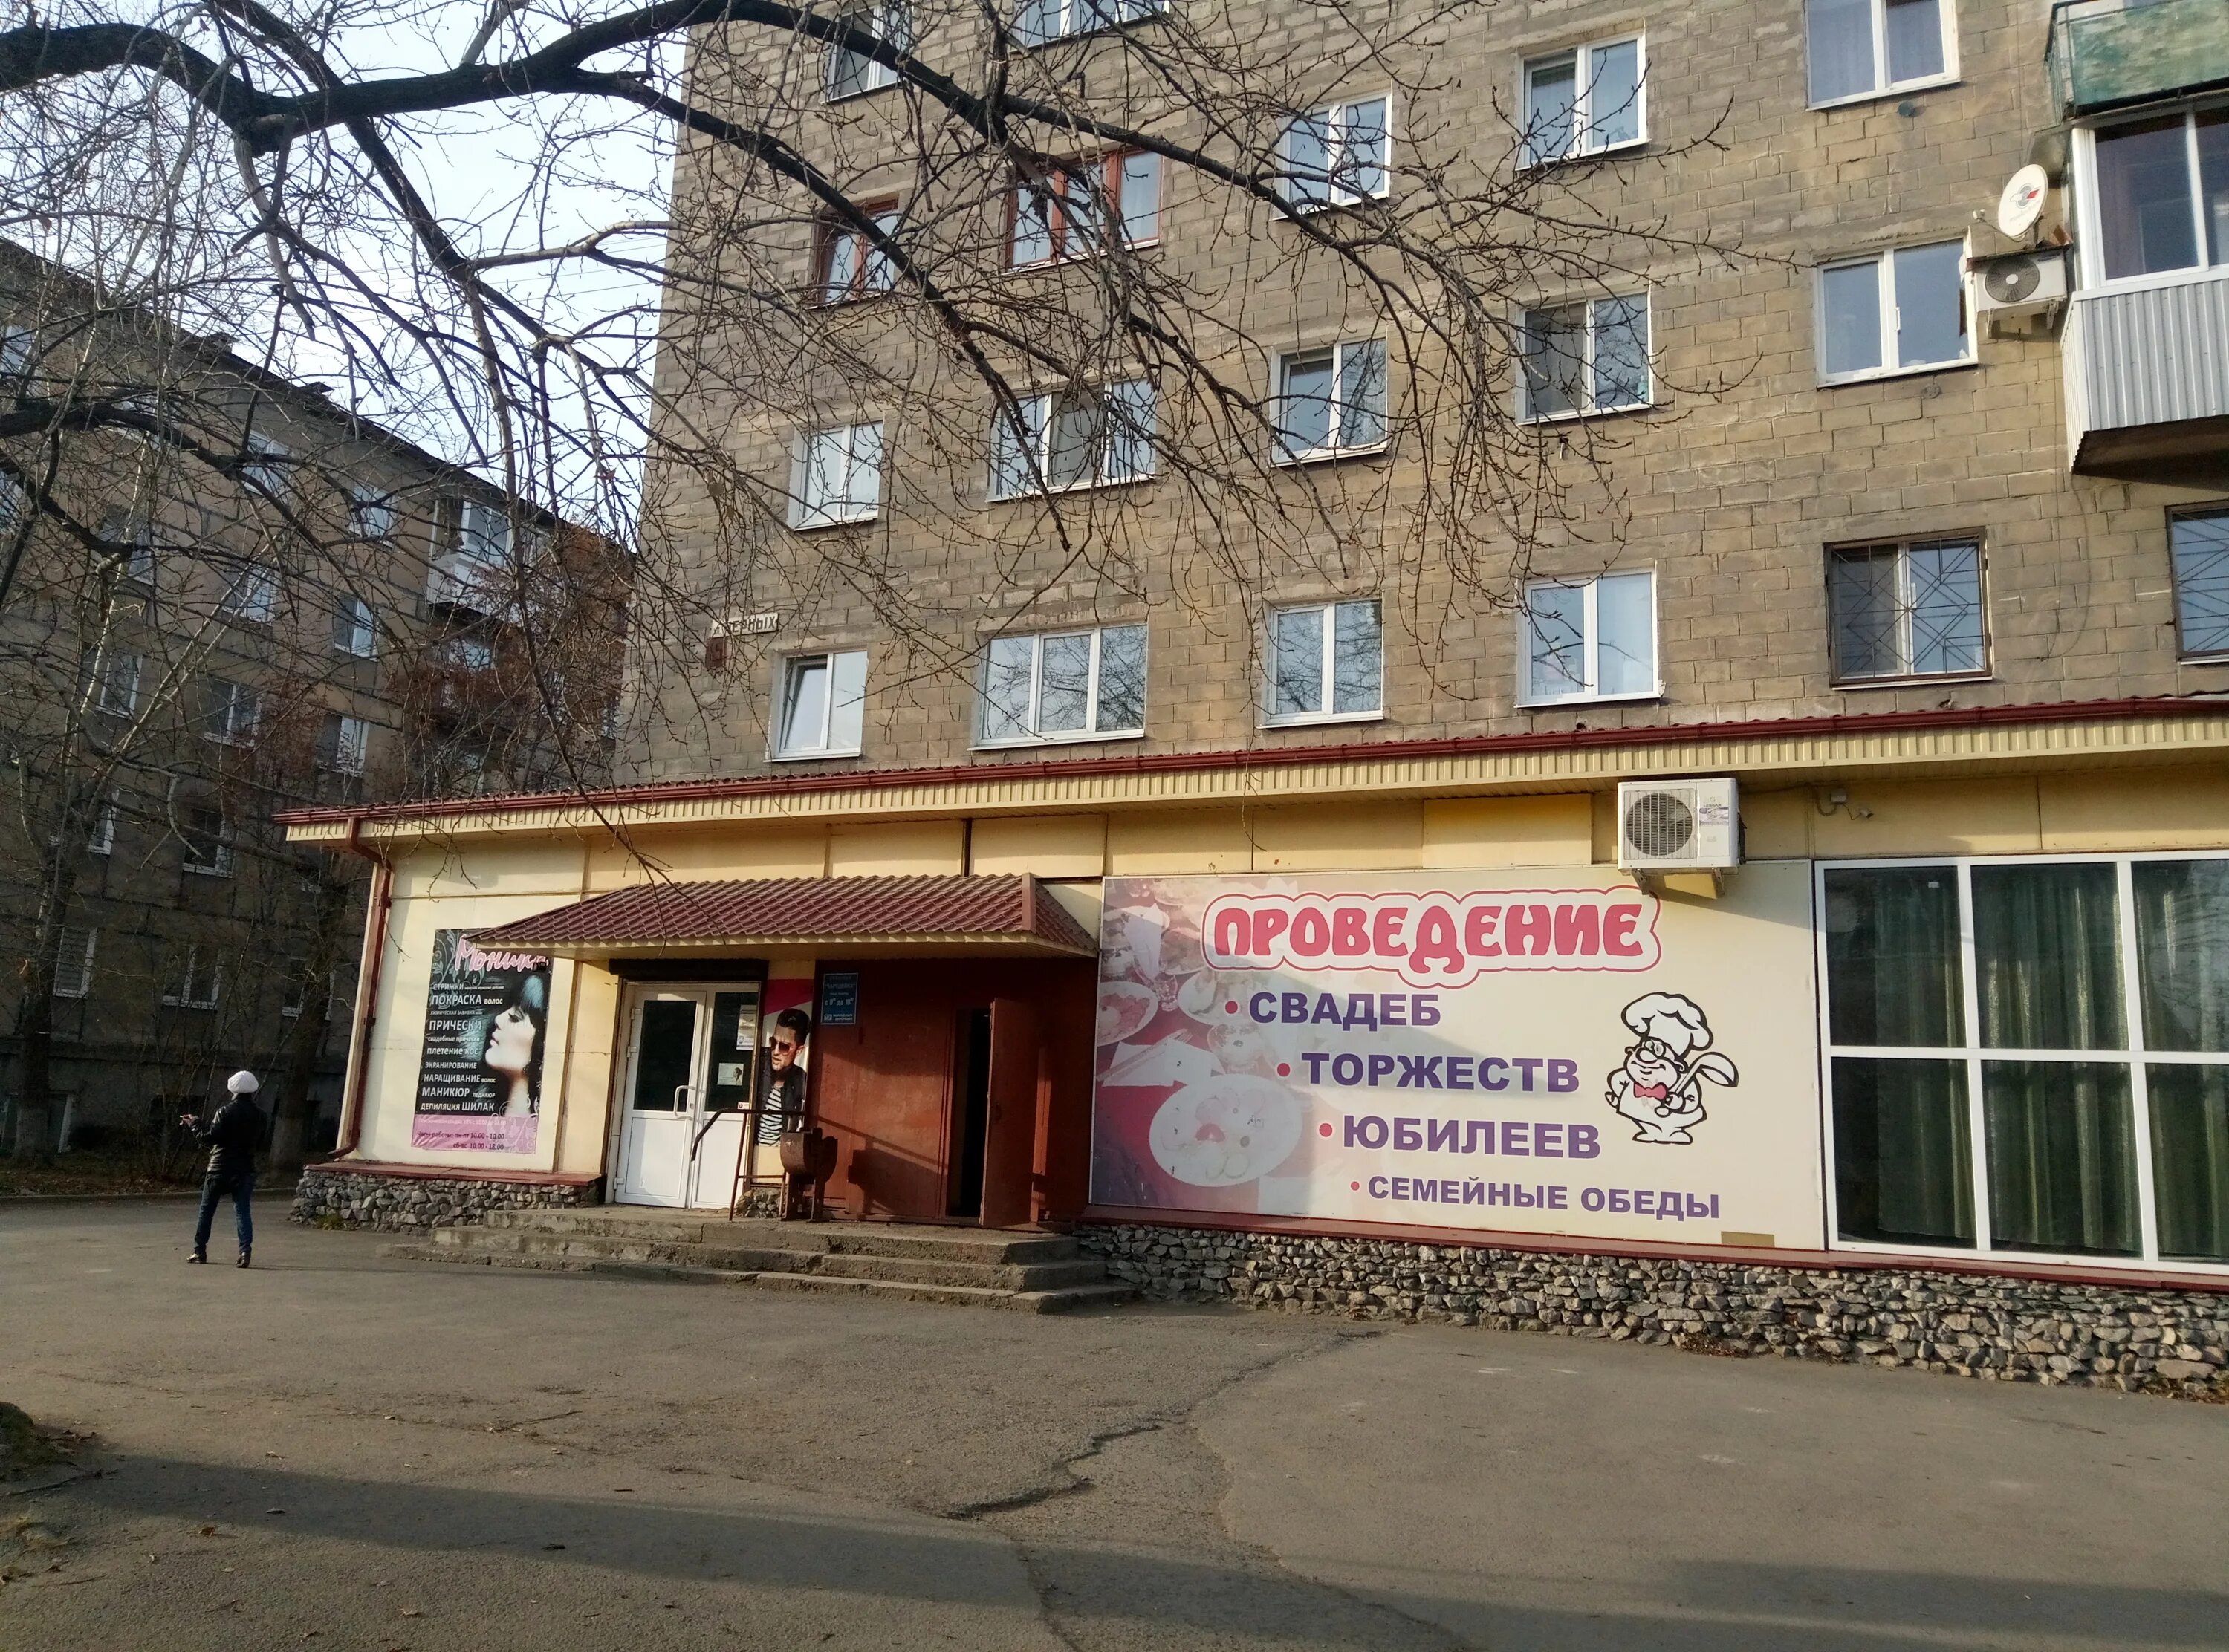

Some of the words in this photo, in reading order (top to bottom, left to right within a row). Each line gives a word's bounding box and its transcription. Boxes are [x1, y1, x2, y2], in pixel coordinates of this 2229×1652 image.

[727, 616, 776, 634] ЕРНЫХ
[1214, 904, 1644, 974] ПРОВЕДЕНИЕ
[433, 983, 464, 991] СТРИЖКИ
[432, 995, 482, 1005] ПОКРАСКА
[1249, 992, 1440, 1031] СВАДЕБ
[429, 1020, 482, 1031] ПРИЧЕСКИ
[424, 1073, 481, 1084] НАРАЩИВАНИЕ
[1302, 1053, 1579, 1092] ТОРЖЕСТВ
[421, 1087, 470, 1098] МАНИКЮР
[420, 1102, 461, 1111] ДЕПИЛЯЦИЯ
[461, 1102, 495, 1112] ШИЛАК
[1343, 1116, 1600, 1158] ЮБИЛЕЕВ
[1368, 1175, 1568, 1209] СЕМЕЙНЫЕ
[1580, 1187, 1720, 1222] ОБЕДЫ
